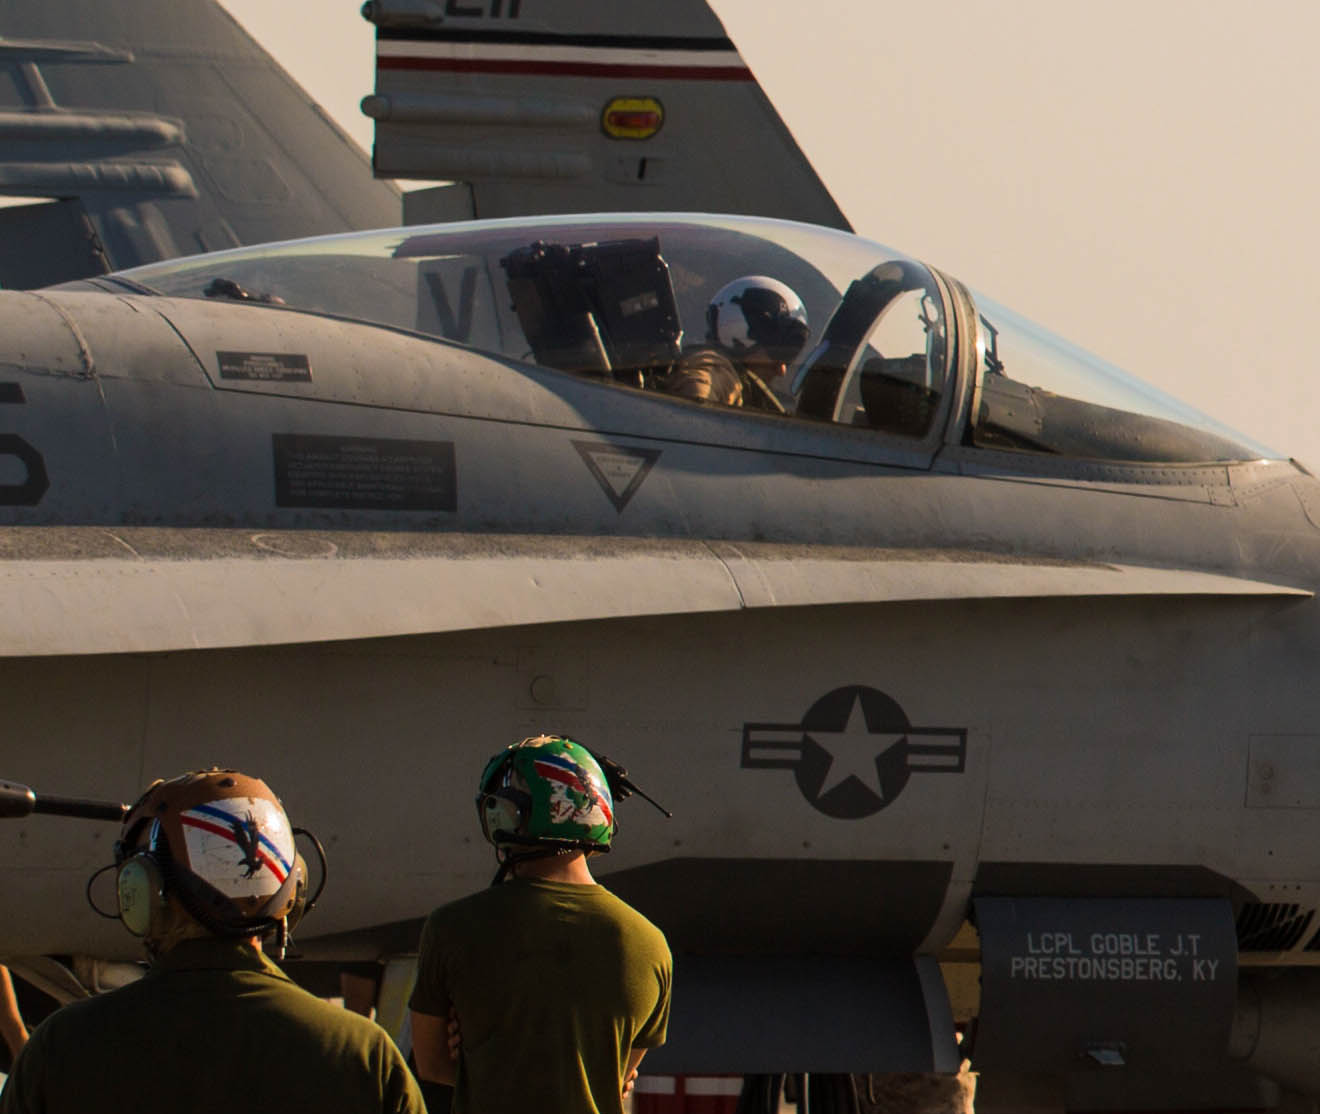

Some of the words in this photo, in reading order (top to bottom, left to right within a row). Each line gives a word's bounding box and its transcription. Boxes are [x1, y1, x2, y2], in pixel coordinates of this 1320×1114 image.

[1027, 932, 1081, 955] LCPL
[1090, 934, 1160, 956] GOBLE
[1010, 957, 1183, 982] PRESTONSBERG,
[1192, 959, 1219, 981] KY
